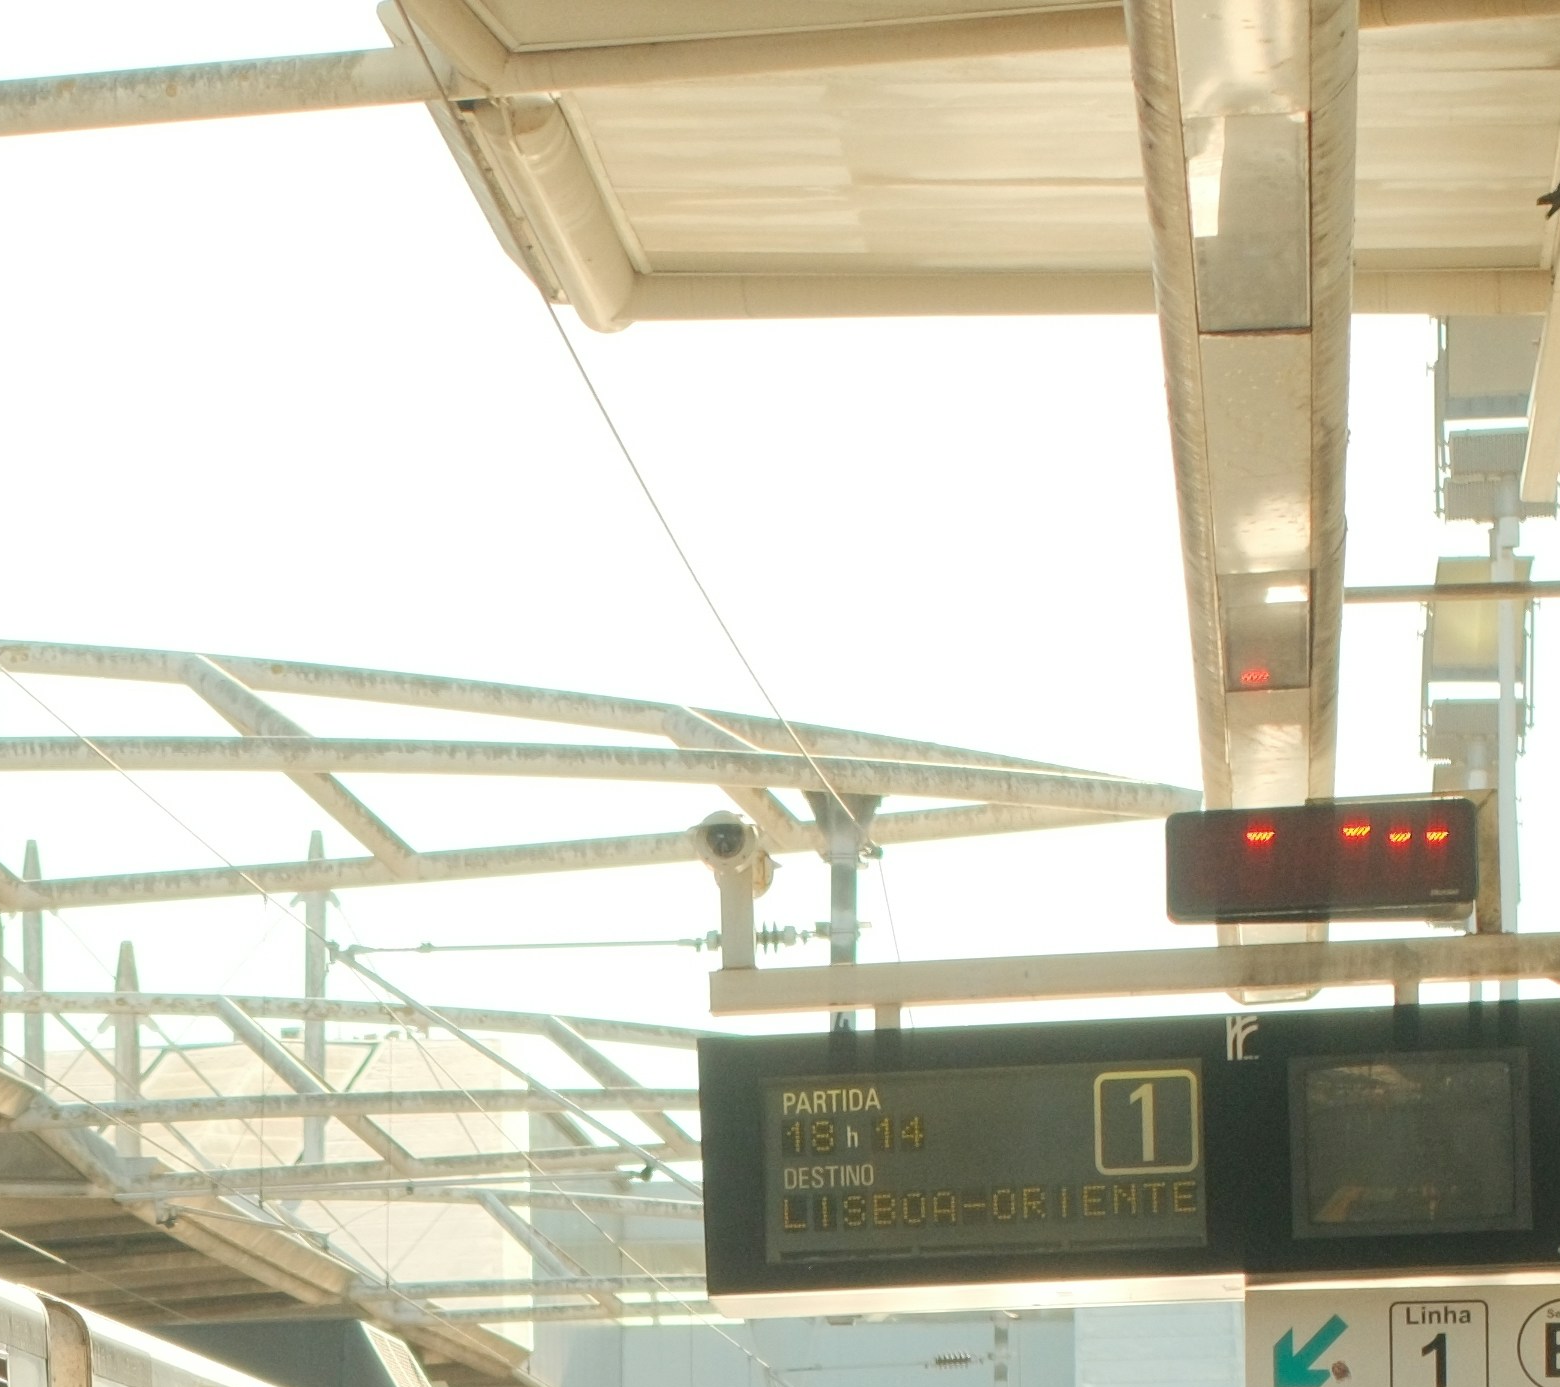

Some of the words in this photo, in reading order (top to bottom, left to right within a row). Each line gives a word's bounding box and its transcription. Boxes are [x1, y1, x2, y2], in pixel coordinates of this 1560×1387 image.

[783, 1088, 881, 1115] PARTIDA
[786, 1119, 834, 1153] 18
[846, 1125, 859, 1148] h
[875, 1115, 924, 1151] 14
[1129, 1083, 1156, 1162] 1
[784, 1163, 875, 1190] DESTINO
[784, 1181, 1198, 1230] LISBOA-ORIENTE
[1405, 1305, 1472, 1326] Linha
